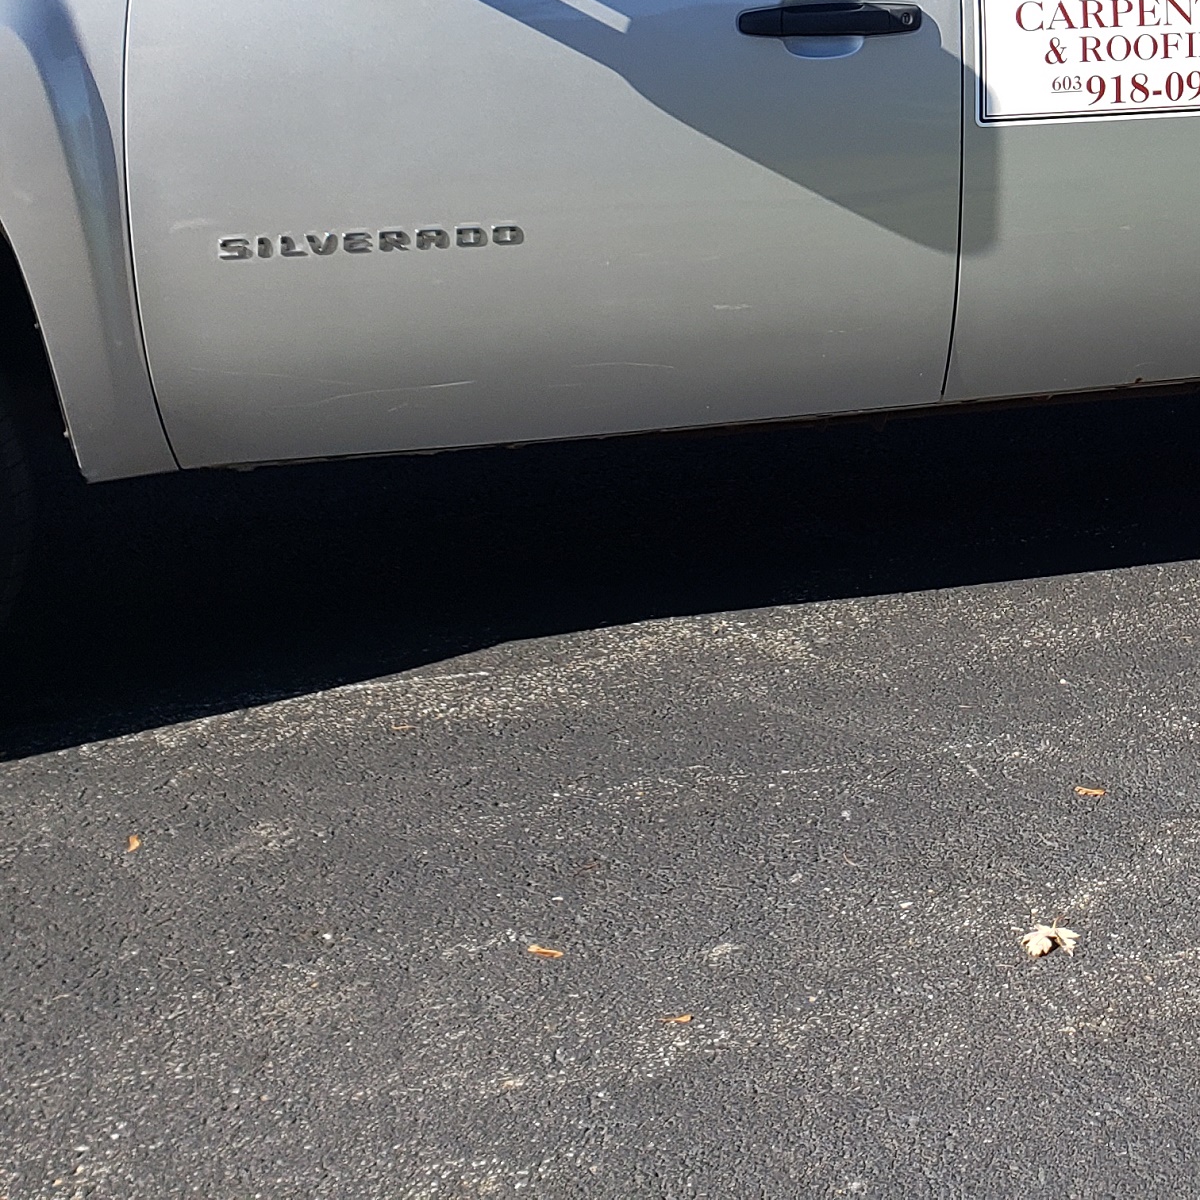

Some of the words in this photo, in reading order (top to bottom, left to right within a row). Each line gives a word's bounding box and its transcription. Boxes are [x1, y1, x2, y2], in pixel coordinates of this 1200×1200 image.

[1044, 36, 1068, 64] &
[1051, 75, 1083, 92] 603
[218, 224, 525, 260] SILVERADO
